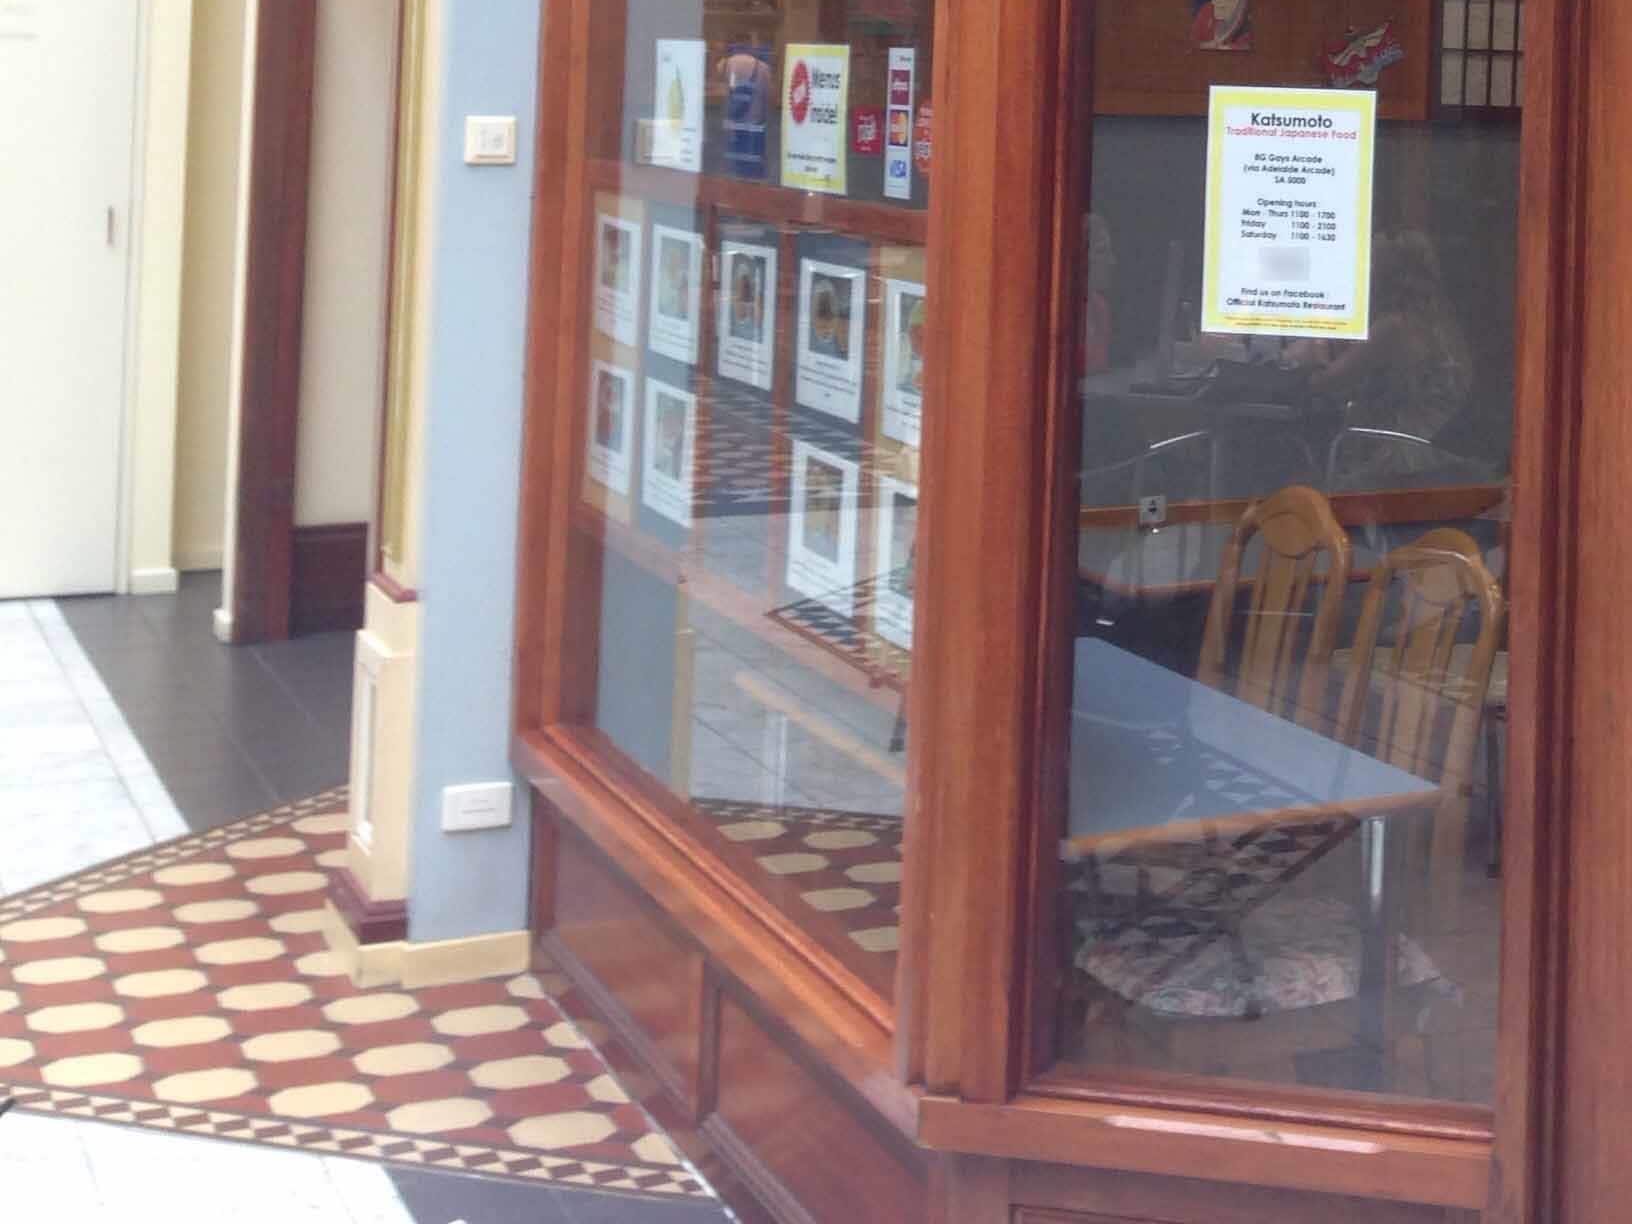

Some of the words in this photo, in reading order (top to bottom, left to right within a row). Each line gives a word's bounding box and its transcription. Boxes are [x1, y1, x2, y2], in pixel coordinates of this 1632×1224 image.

[1251, 112, 1333, 128] Katsumoto
[1226, 127, 1277, 137] Traditional
[1280, 128, 1329, 139] Japanese
[1332, 129, 1357, 140] Food
[1292, 154, 1323, 164] Arcade
[1262, 164, 1299, 173] Adelaide
[1301, 166, 1336, 176] Arcade)
[1274, 176, 1285, 184] SA
[1257, 198, 1293, 209] Opening
[1268, 209, 1289, 218] Thurs
[1291, 210, 1310, 219] 1100
[1317, 211, 1336, 220] 1700
[1241, 219, 1267, 229] Friday
[1291, 221, 1310, 230] 1100
[1317, 222, 1336, 231] 2100
[1241, 229, 1277, 240] Saturday
[1291, 232, 1310, 241] 1100
[1241, 287, 1258, 297] Find
[1271, 289, 1282, 297] on
[1283, 288, 1325, 299] Facebook
[1226, 297, 1256, 307] Official
[1257, 298, 1301, 309] Katsumoto
[1303, 301, 1346, 311] Restaurant
